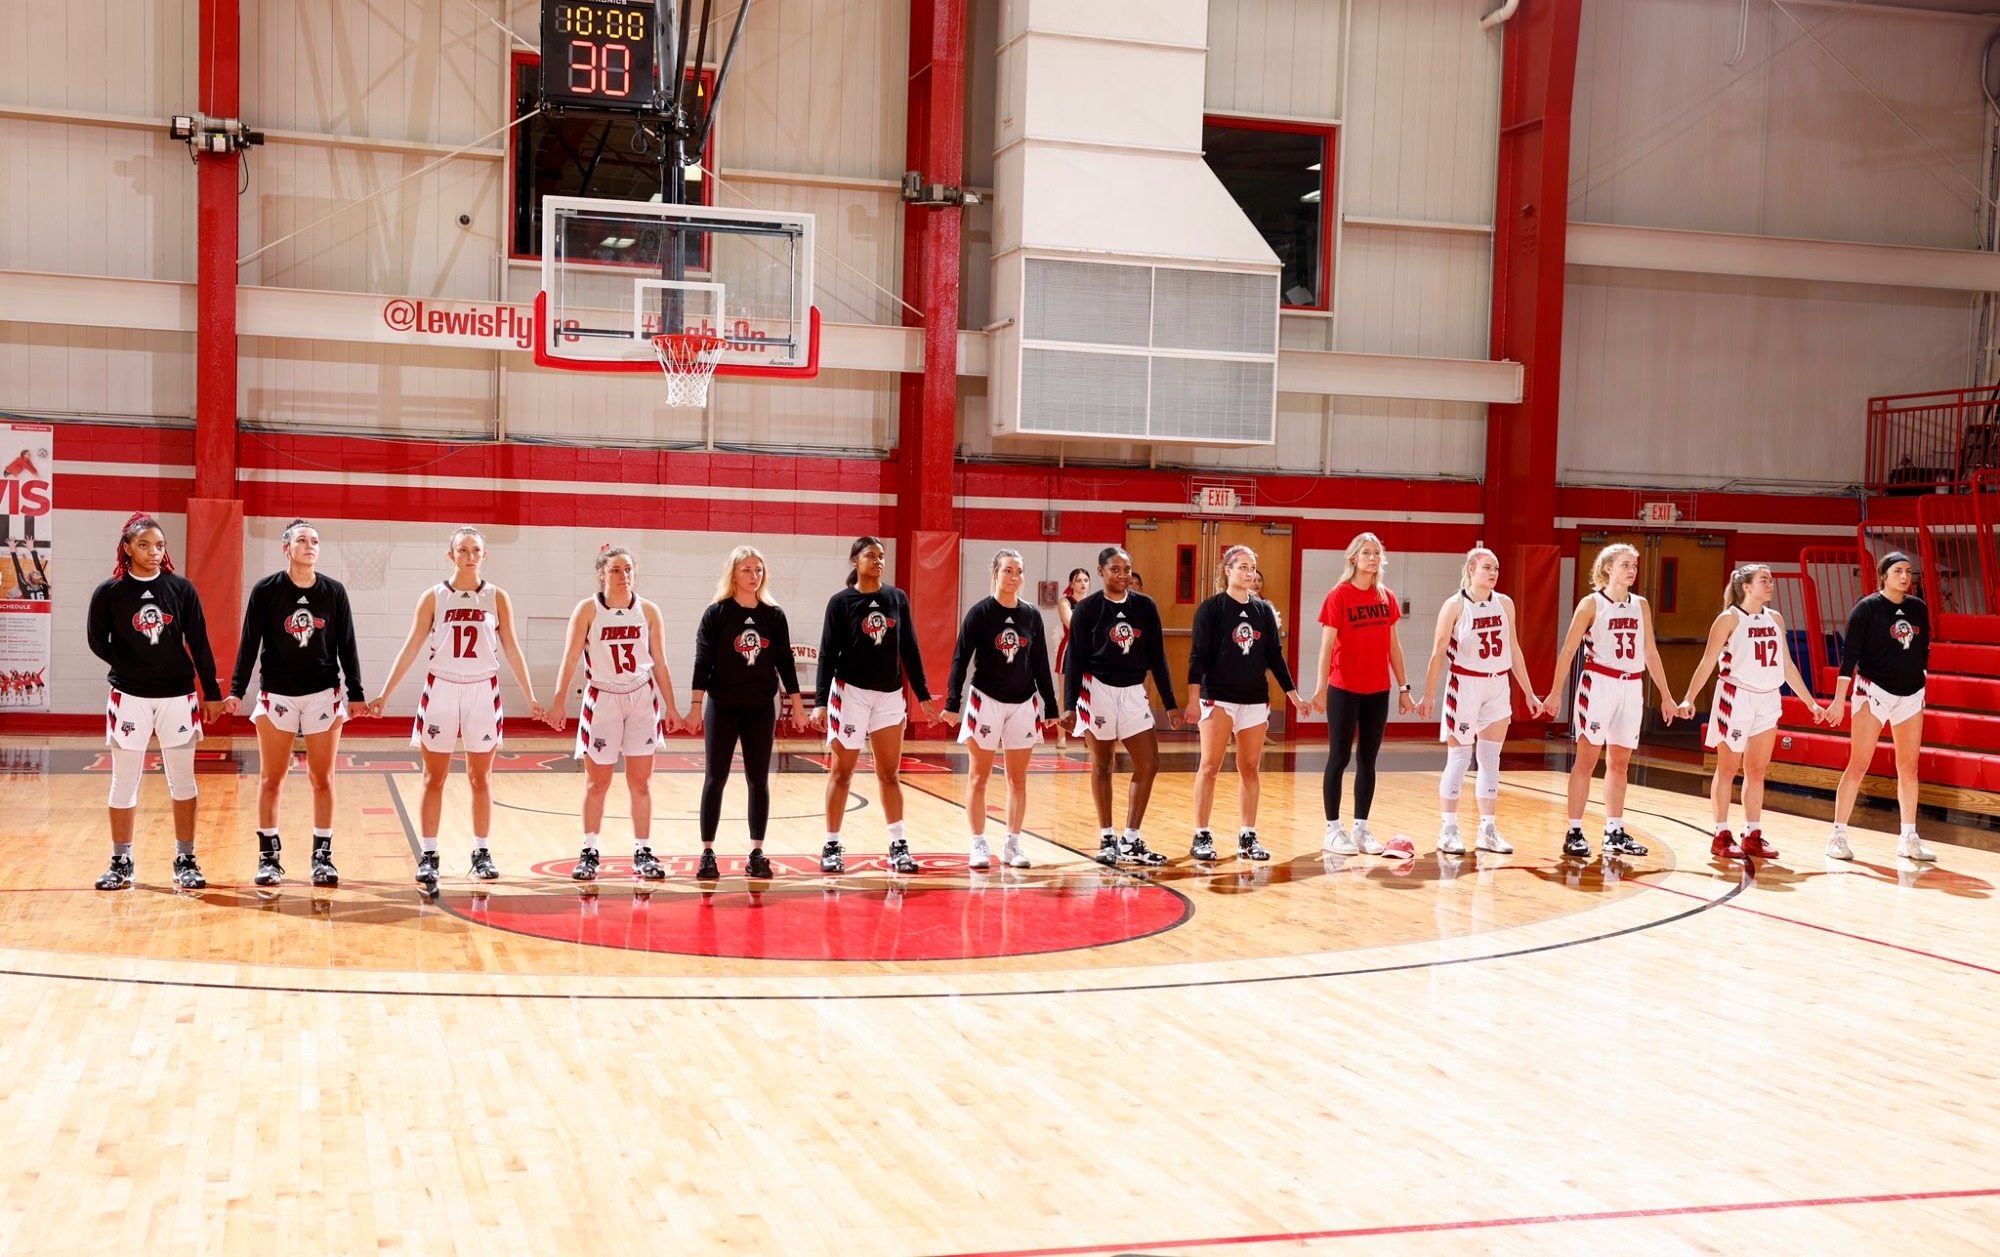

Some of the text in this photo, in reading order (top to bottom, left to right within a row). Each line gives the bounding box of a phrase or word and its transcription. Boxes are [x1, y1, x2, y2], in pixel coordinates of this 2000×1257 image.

[566, 6, 644, 40] 10:00
[571, 40, 630, 96] 30
[1208, 489, 1230, 506] EXIT
[1652, 504, 1672, 520] EXIT
[452, 625, 478, 658] 12
[1477, 630, 1503, 660] 35
[1613, 632, 1636, 660] 33
[1754, 639, 1778, 667] 42
[609, 643, 637, 675] 13
